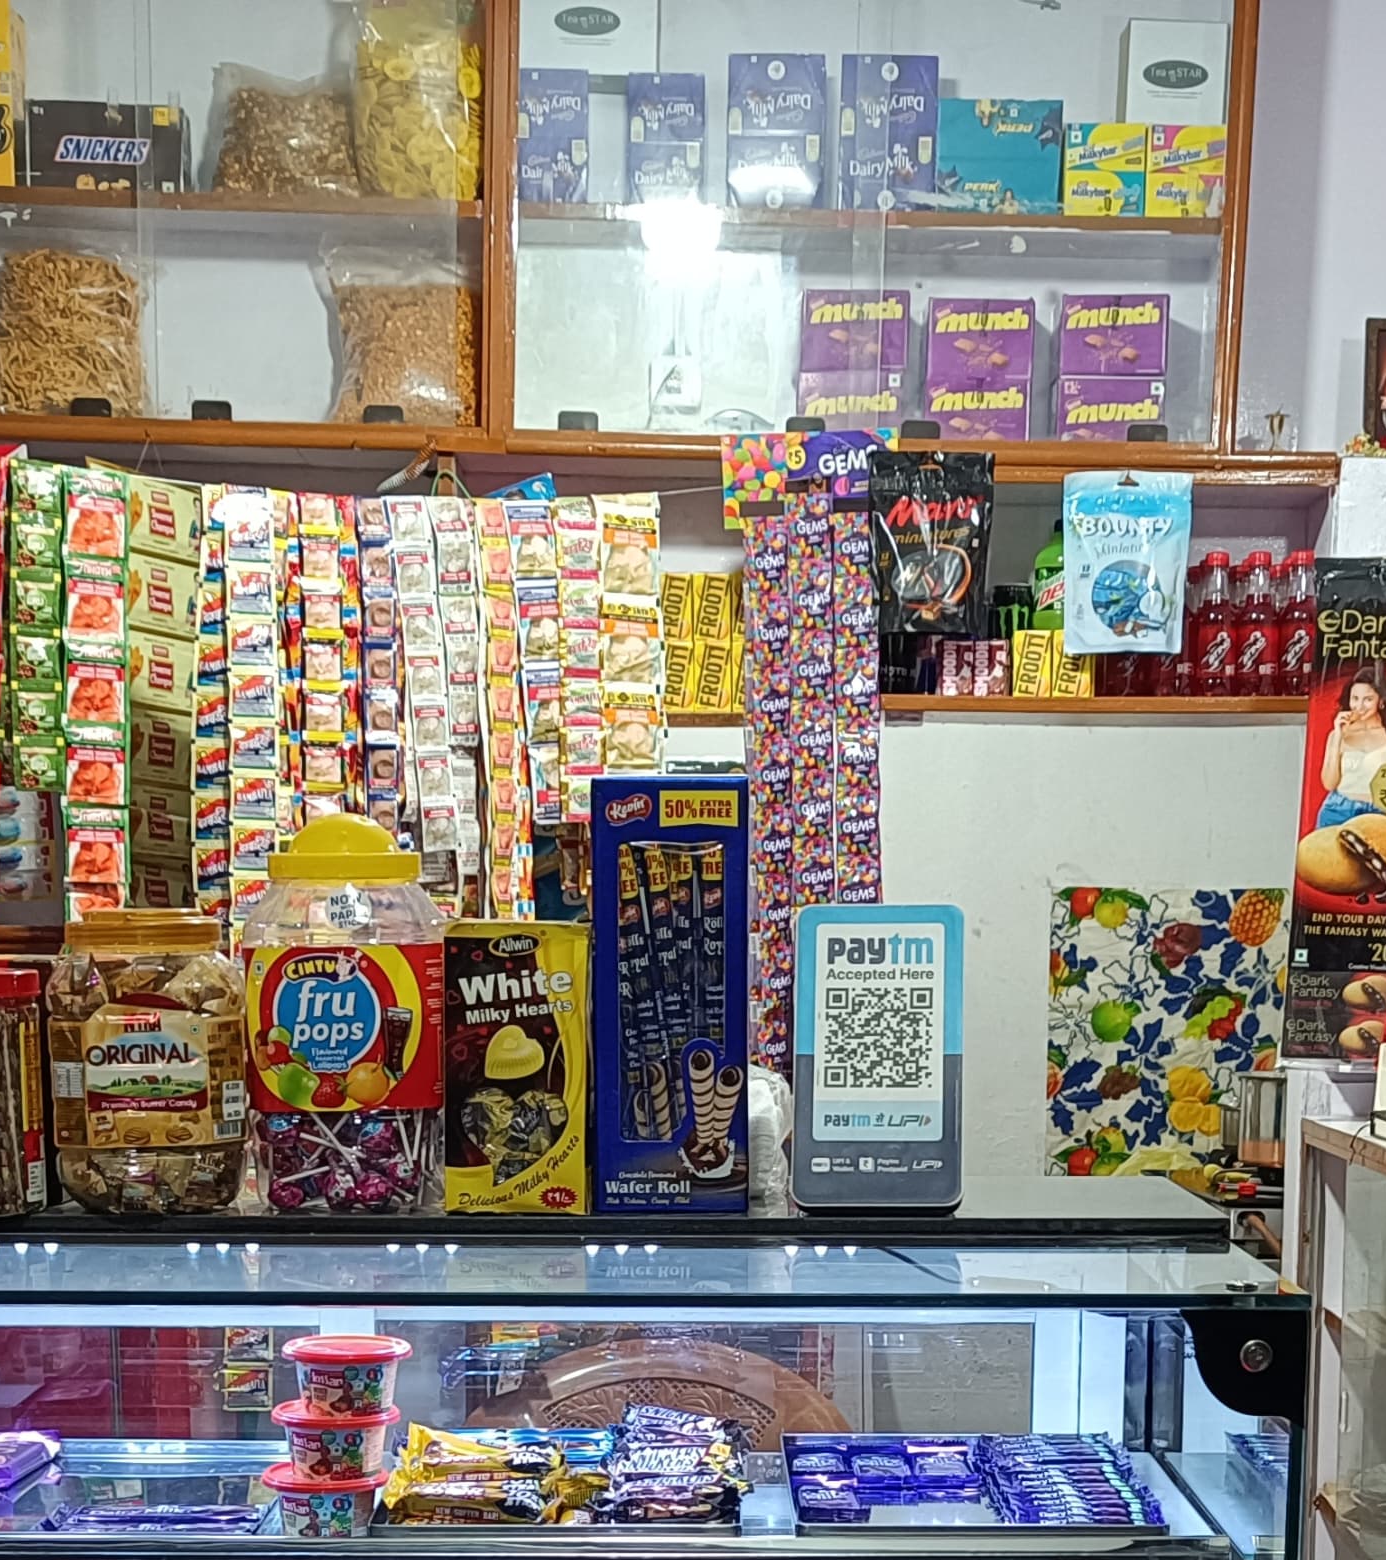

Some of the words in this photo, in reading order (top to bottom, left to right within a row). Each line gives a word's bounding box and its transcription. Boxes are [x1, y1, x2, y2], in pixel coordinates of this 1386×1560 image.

[776, 93, 811, 111] Dairy
[888, 95, 924, 112] Dairy
[59, 137, 149, 163] SNICKERS
[849, 160, 885, 179] Dairy
[810, 297, 904, 326] munch
[935, 307, 1031, 335] munch
[1066, 301, 1161, 330] munch
[804, 390, 898, 417] munch
[930, 386, 1025, 413] munch
[1066, 398, 1160, 425] munch
[886, 494, 985, 528] Mars
[796, 518, 829, 536] GEMS
[1081, 516, 1174, 538] BOUNTY
[664, 575, 688, 639] FROOTI
[700, 576, 726, 640] FROOTI
[761, 625, 789, 641] GEMS
[799, 661, 832, 677] GEMS
[1018, 632, 1048, 697] FROOTI
[664, 644, 689, 708] FROOTI
[700, 644, 726, 708] FROOTI
[761, 696, 790, 712] GEMS
[800, 731, 832, 747] GEMS
[763, 766, 790, 782] GEMS
[665, 799, 698, 818] 50%
[699, 807, 732, 818] FREE
[843, 818, 876, 834] GEMS
[763, 836, 791, 852] GEMS
[802, 869, 833, 885] GEMS
[843, 887, 876, 902] GEMS
[1312, 913, 1334, 924] END
[1336, 914, 1364, 925] YOUR
[1303, 925, 1322, 935] THE
[1324, 926, 1368, 937] FANTASY
[497, 936, 534, 955] Allwin
[826, 933, 934, 966] paytm
[826, 968, 896, 984] Accepted
[899, 968, 934, 982] Here
[1298, 974, 1331, 987] Dark
[459, 967, 574, 1005] White
[1291, 986, 1341, 1000] Fantasy
[297, 981, 356, 1023] fru
[465, 1006, 511, 1026] Milky
[513, 998, 574, 1020] Hearts
[292, 1021, 365, 1049] pops
[1294, 1019, 1327, 1032] Dark
[1287, 1030, 1338, 1045] Fantasy
[85, 1042, 196, 1066] ORIGINAL
[824, 1114, 871, 1128] paytm
[513, 1171, 550, 1197] Milky
[546, 1134, 580, 1173] Hearts
[605, 1180, 653, 1194] Wafer
[657, 1180, 691, 1194] Roll
